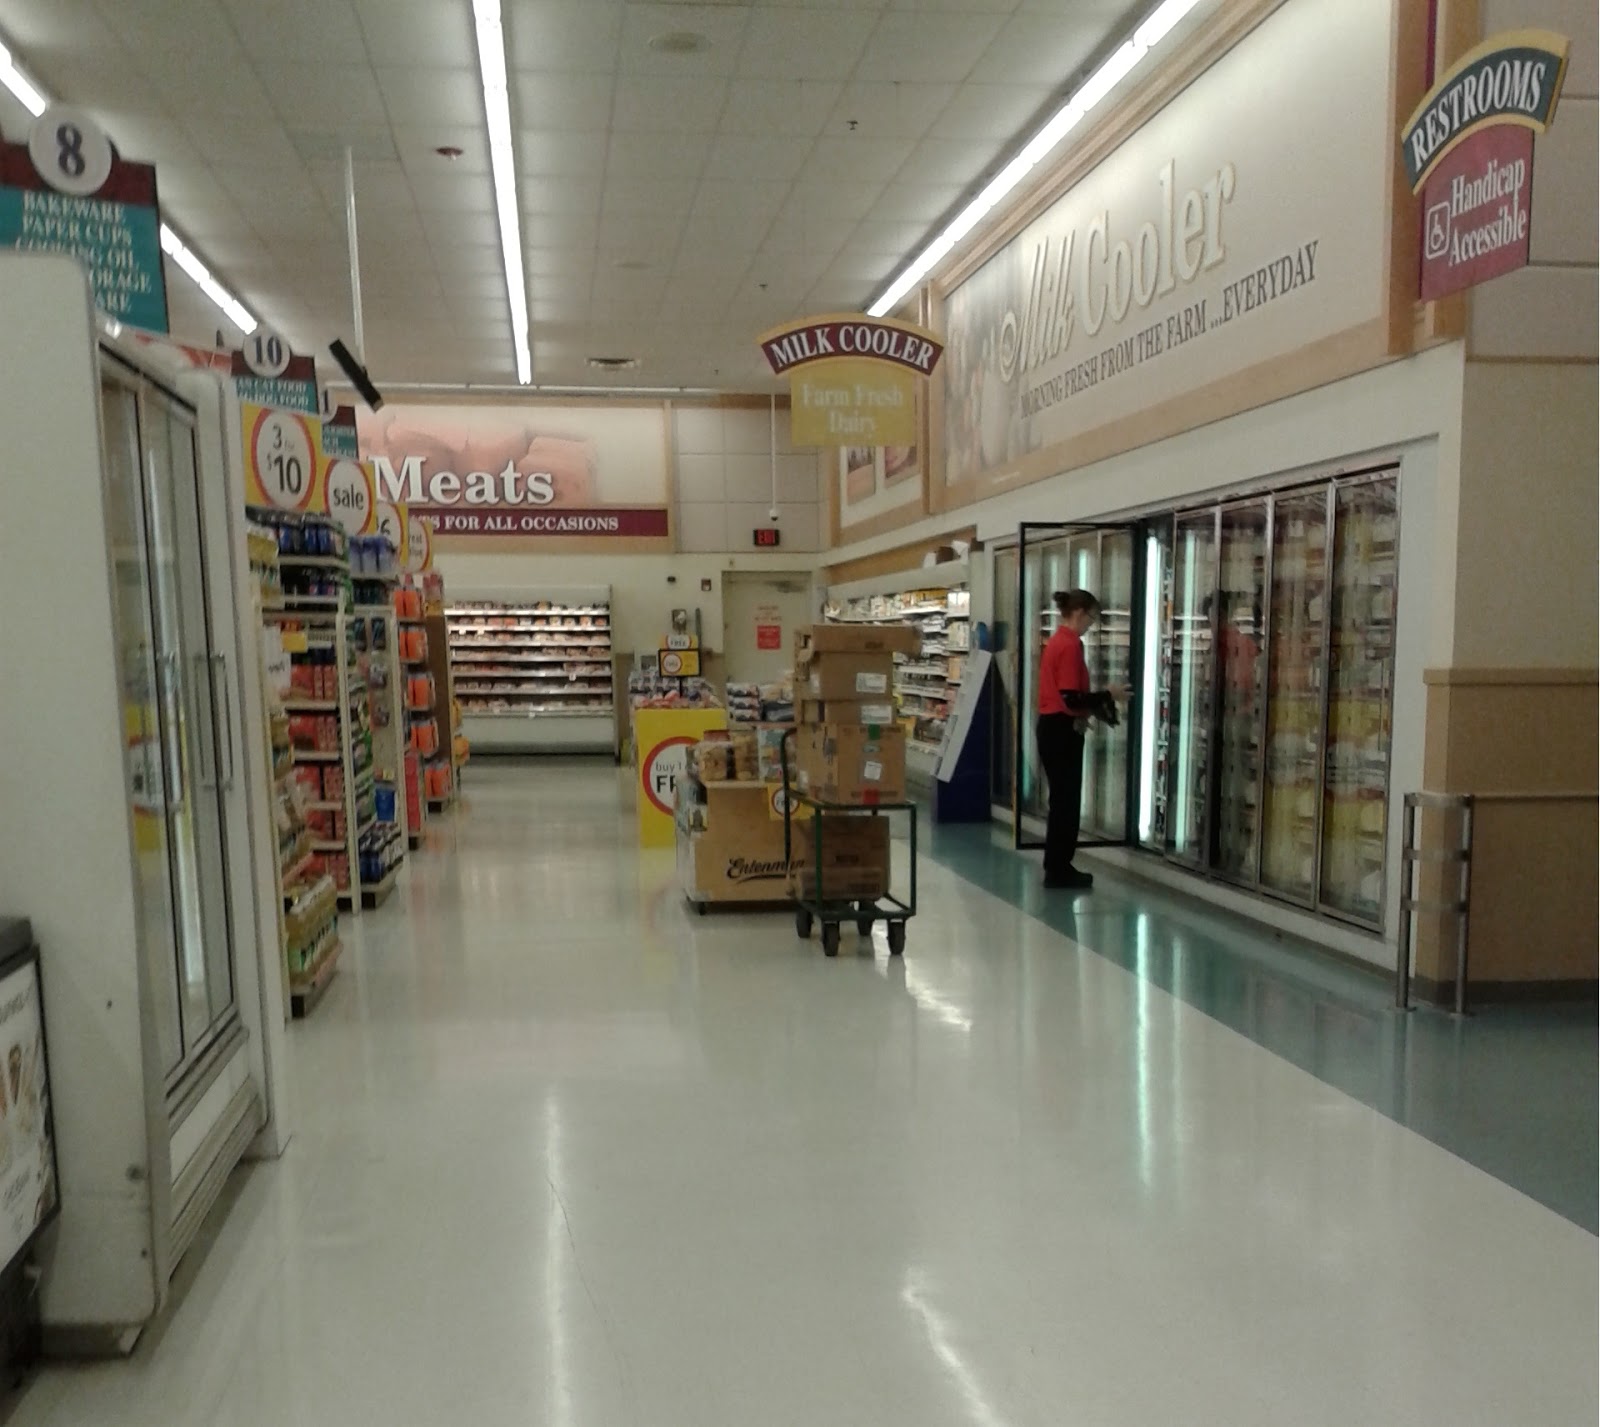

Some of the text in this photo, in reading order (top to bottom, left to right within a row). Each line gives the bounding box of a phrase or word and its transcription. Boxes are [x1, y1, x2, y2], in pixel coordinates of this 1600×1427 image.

[1410, 59, 1547, 173] RESTROOMS
[56, 124, 86, 177] 8
[1451, 158, 1526, 217] Handicap
[22, 190, 127, 225] BAKEWARE
[22, 214, 81, 240] PAPER
[1449, 199, 1527, 267] Accessible
[1000, 158, 1237, 384] Milk Cooler
[252, 335, 283, 367] 10
[769, 325, 934, 370] MILK COOLER
[1020, 375, 1063, 420] MORNING
[1064, 355, 1099, 399] FRESH
[1100, 337, 1135, 381] FROM
[1137, 322, 1163, 363] THE
[1166, 299, 1207, 350] FARM
[801, 383, 904, 408] Farm Fresh
[272, 423, 282, 449] 3
[829, 410, 877, 438] Dairy
[333, 483, 364, 511] sale
[367, 455, 555, 505] Meats
[445, 515, 480, 531] FOR
[484, 515, 518, 531] ALL
[521, 516, 619, 532] OCCASIONS
[655, 761, 675, 773] buy
